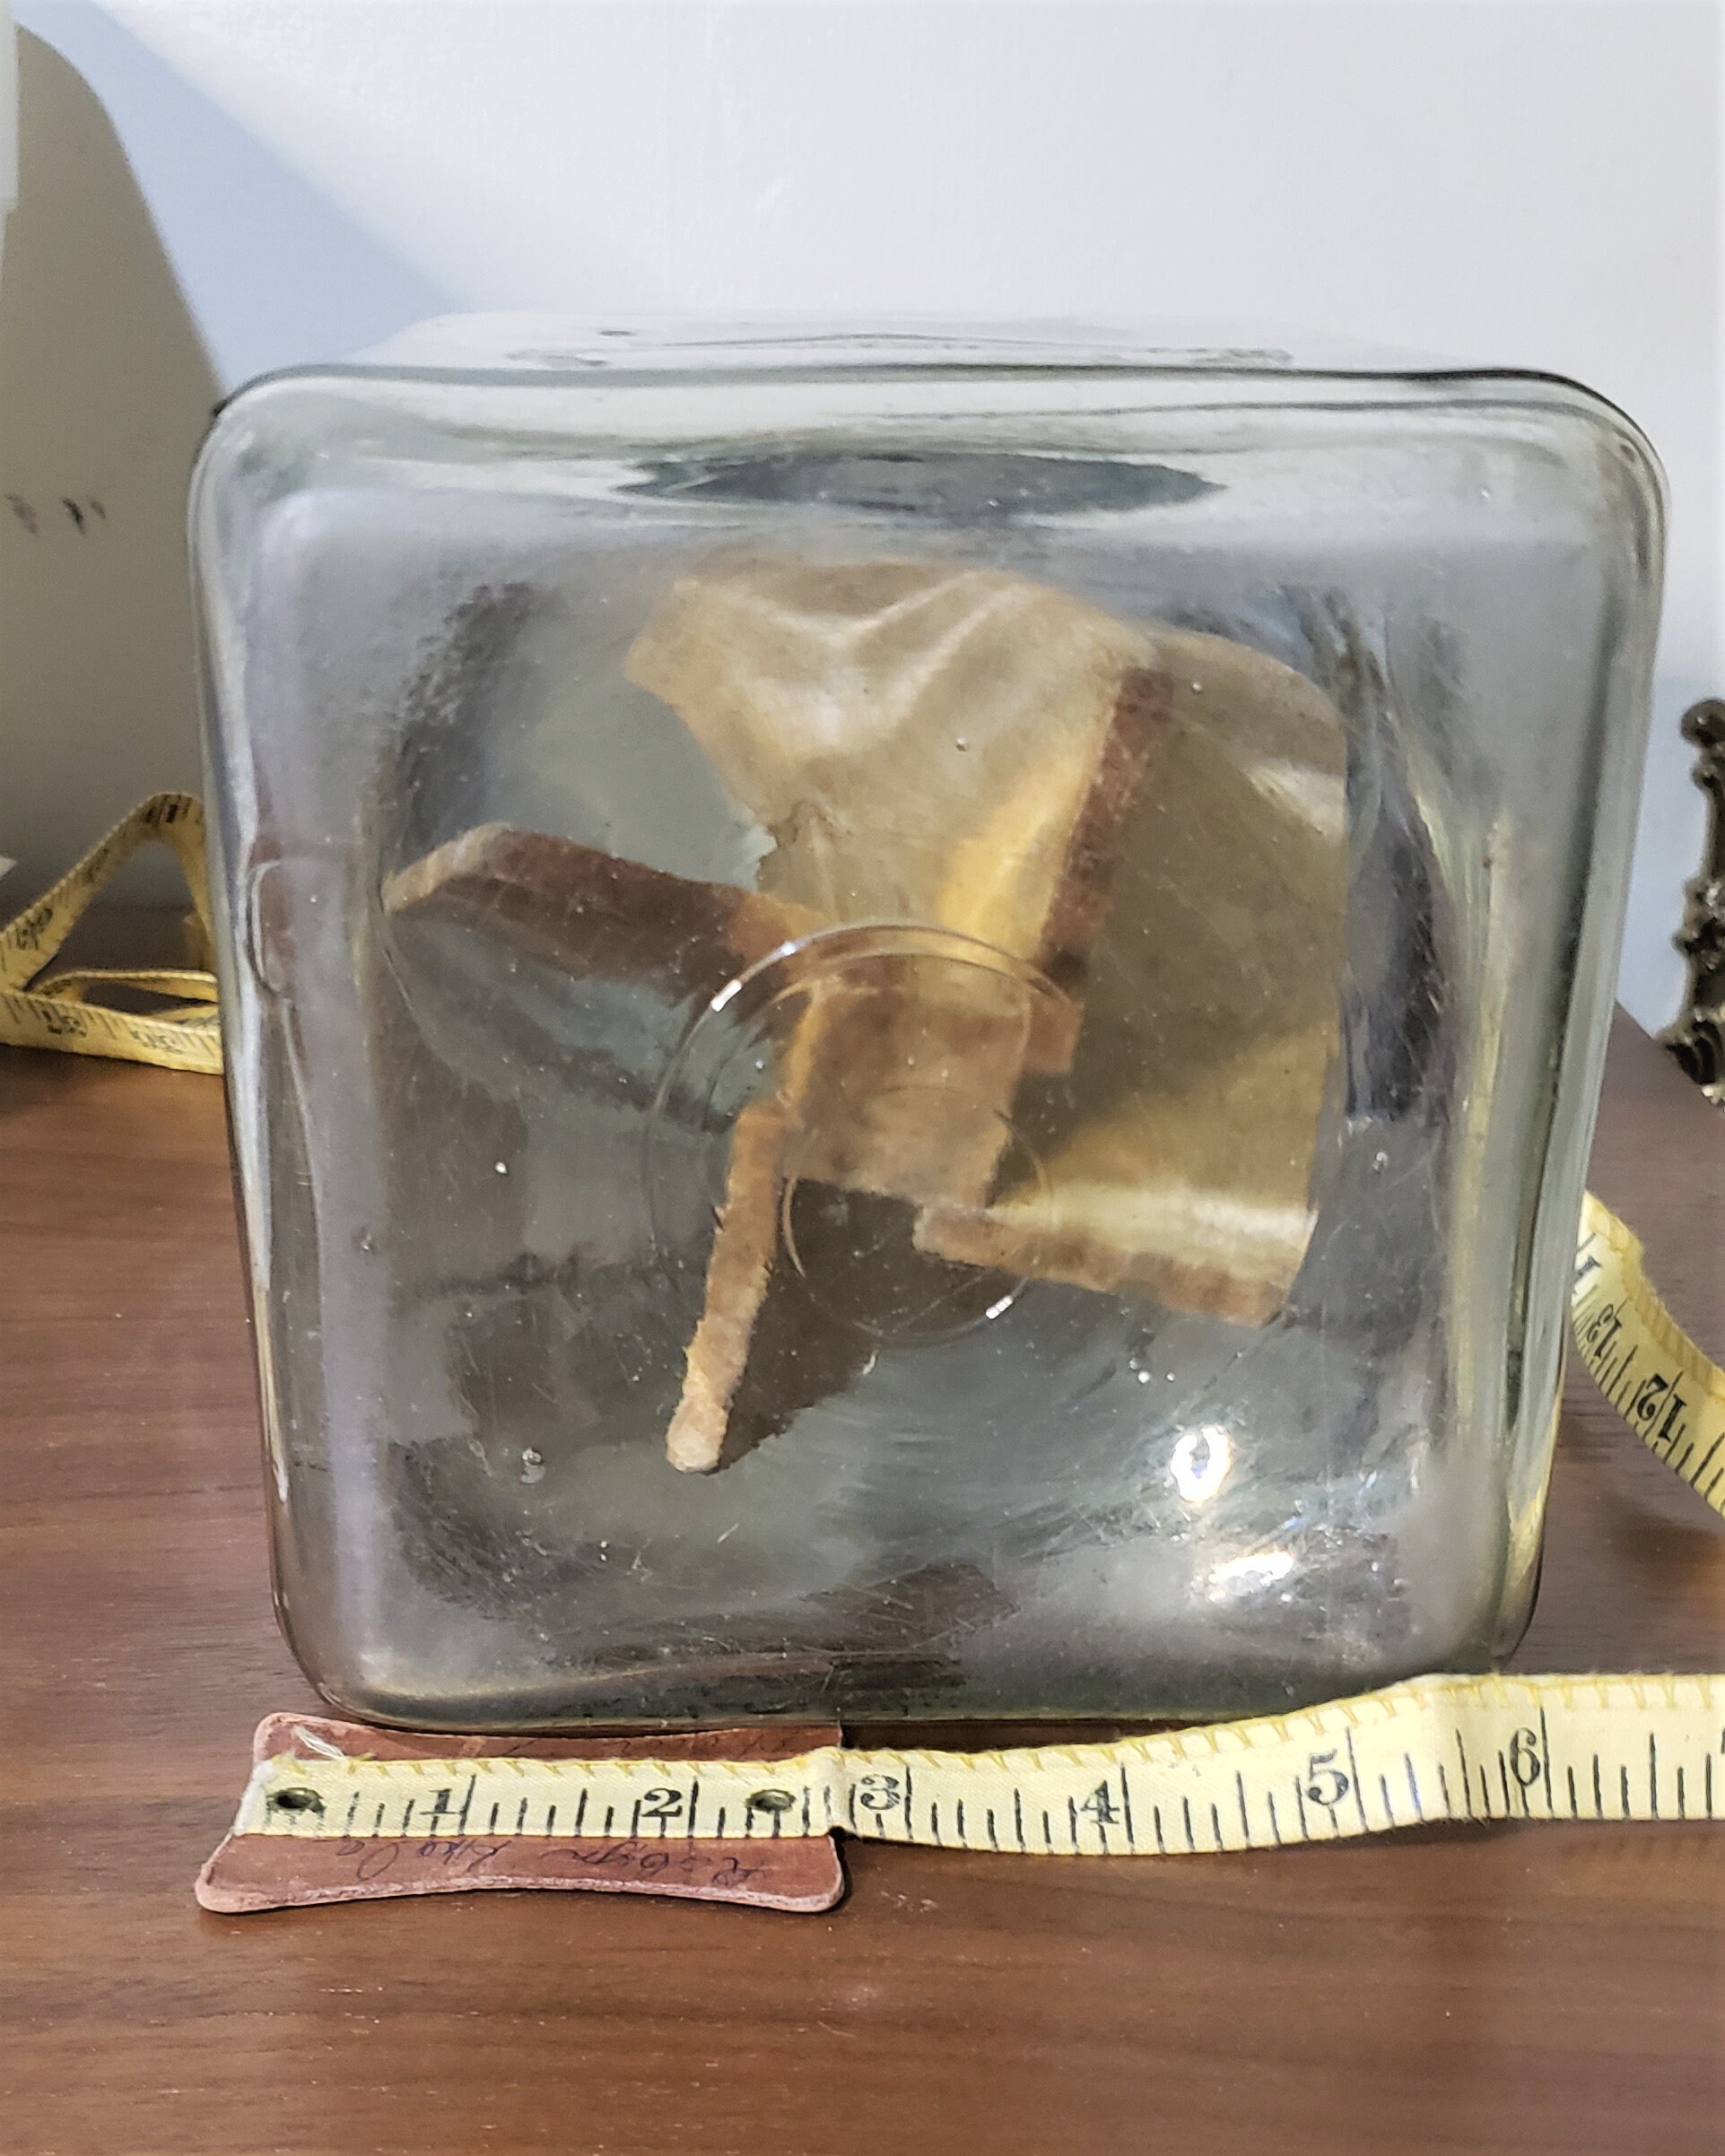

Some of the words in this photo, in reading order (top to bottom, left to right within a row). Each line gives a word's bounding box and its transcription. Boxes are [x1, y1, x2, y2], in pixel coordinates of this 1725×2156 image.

[1587, 1303, 1622, 1359] 13
[1637, 1374, 1687, 1442] 12
[419, 1788, 457, 1814] 1
[640, 1787, 683, 1817] 2
[860, 1775, 901, 1810] 3
[1080, 1780, 1120, 1823] 4
[1308, 1748, 1350, 1805] 5
[1510, 1727, 1540, 1787] 6
